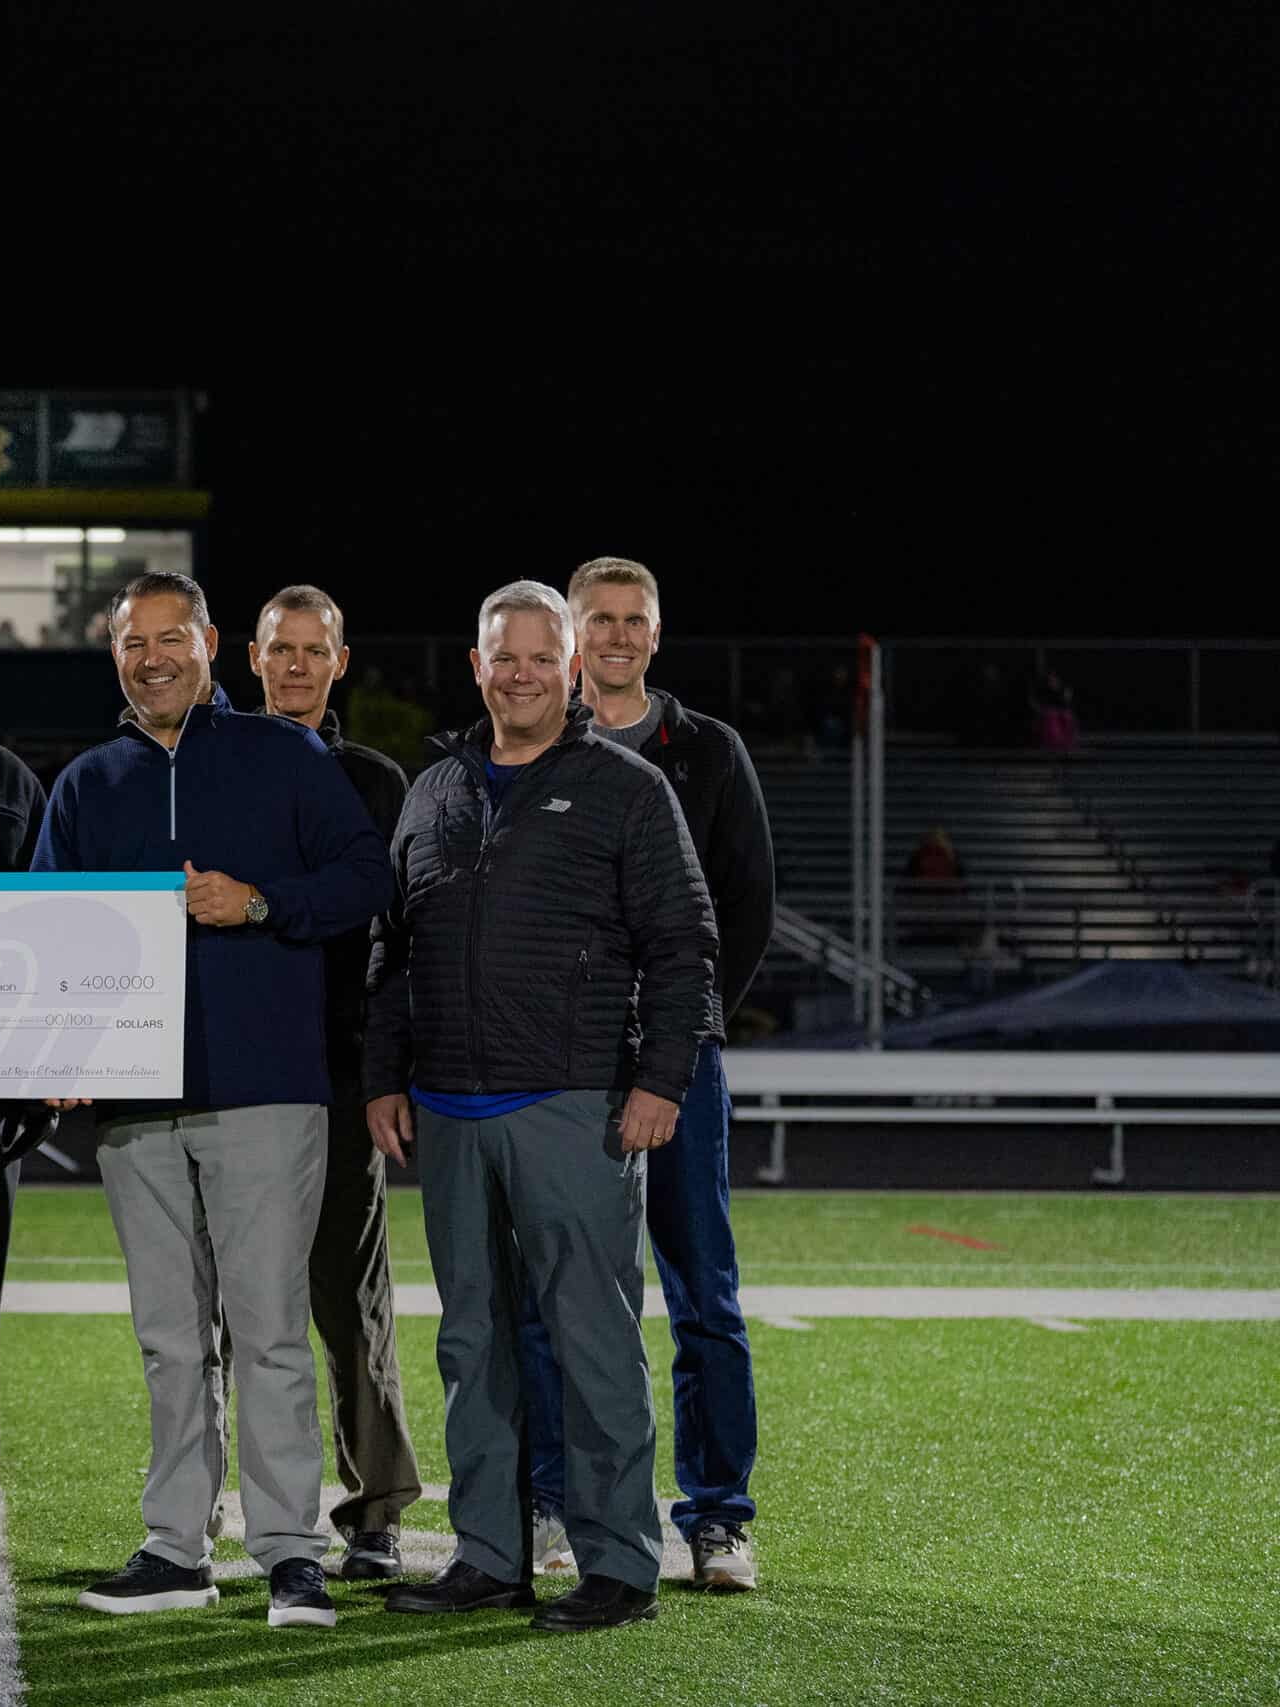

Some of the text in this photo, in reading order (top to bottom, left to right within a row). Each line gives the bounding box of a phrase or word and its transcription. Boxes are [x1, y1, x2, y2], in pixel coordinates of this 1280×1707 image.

[59, 975, 155, 993] $ 400,000
[116, 1019, 164, 1030] DOLLARS
